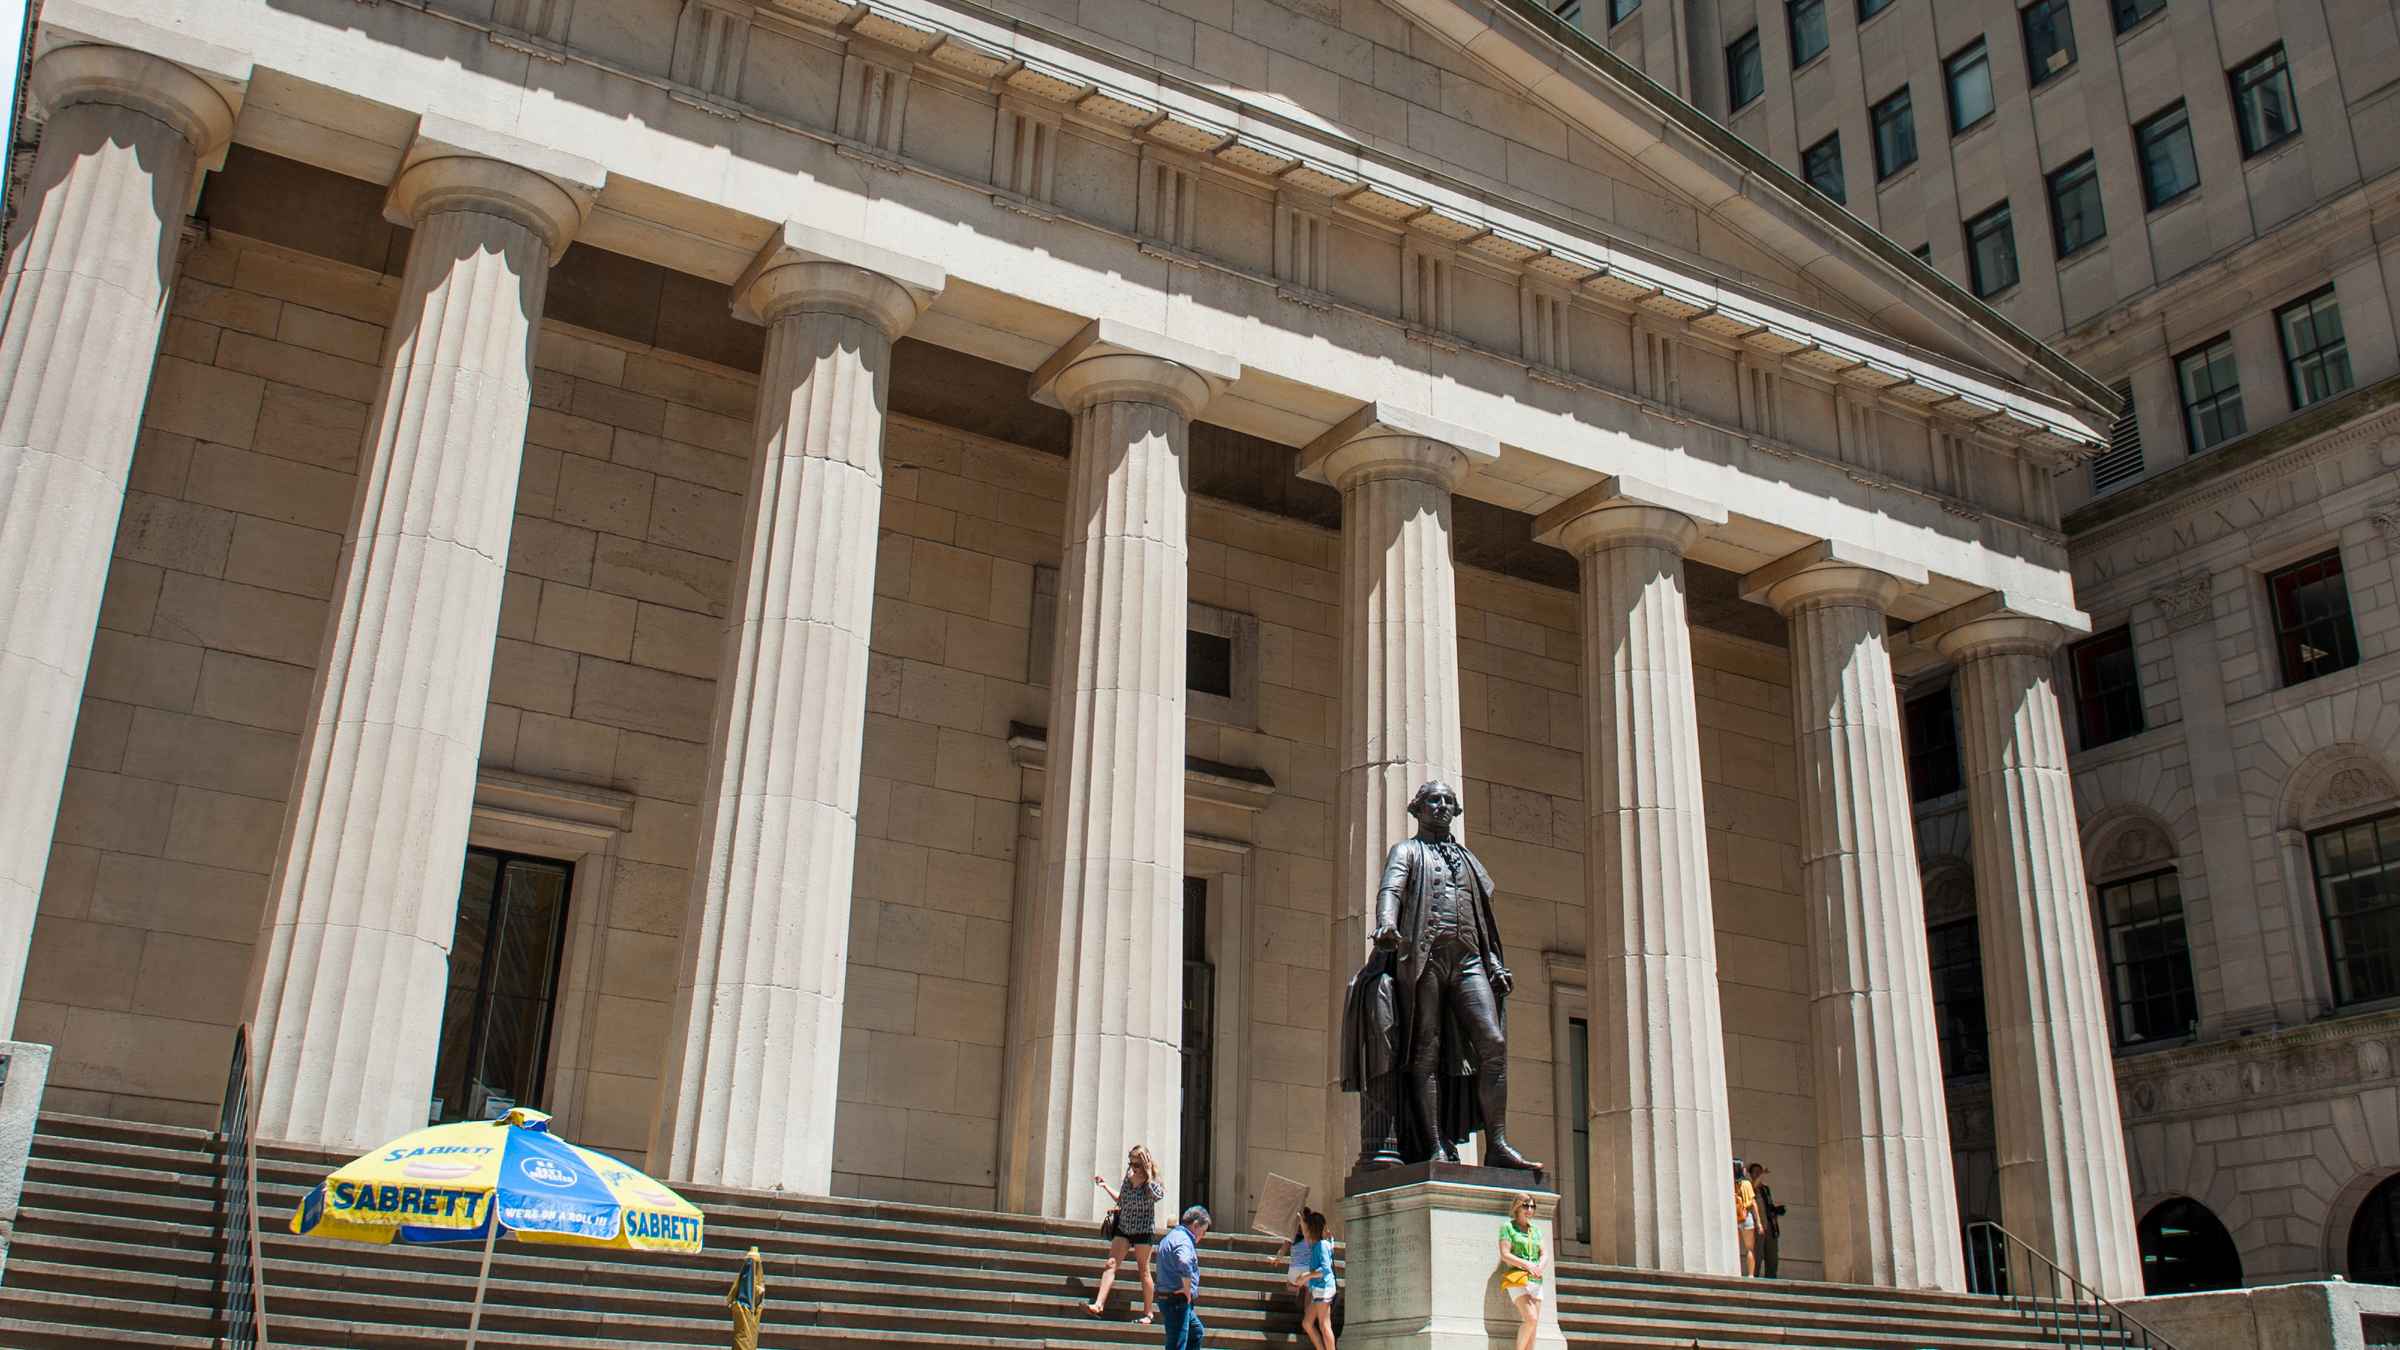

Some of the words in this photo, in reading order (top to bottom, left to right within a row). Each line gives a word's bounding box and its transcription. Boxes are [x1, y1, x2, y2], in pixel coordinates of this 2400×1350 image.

[384, 1145, 494, 1162] SABRETT
[334, 1182, 485, 1218] SABRETT
[626, 1210, 699, 1242] SABRETT
